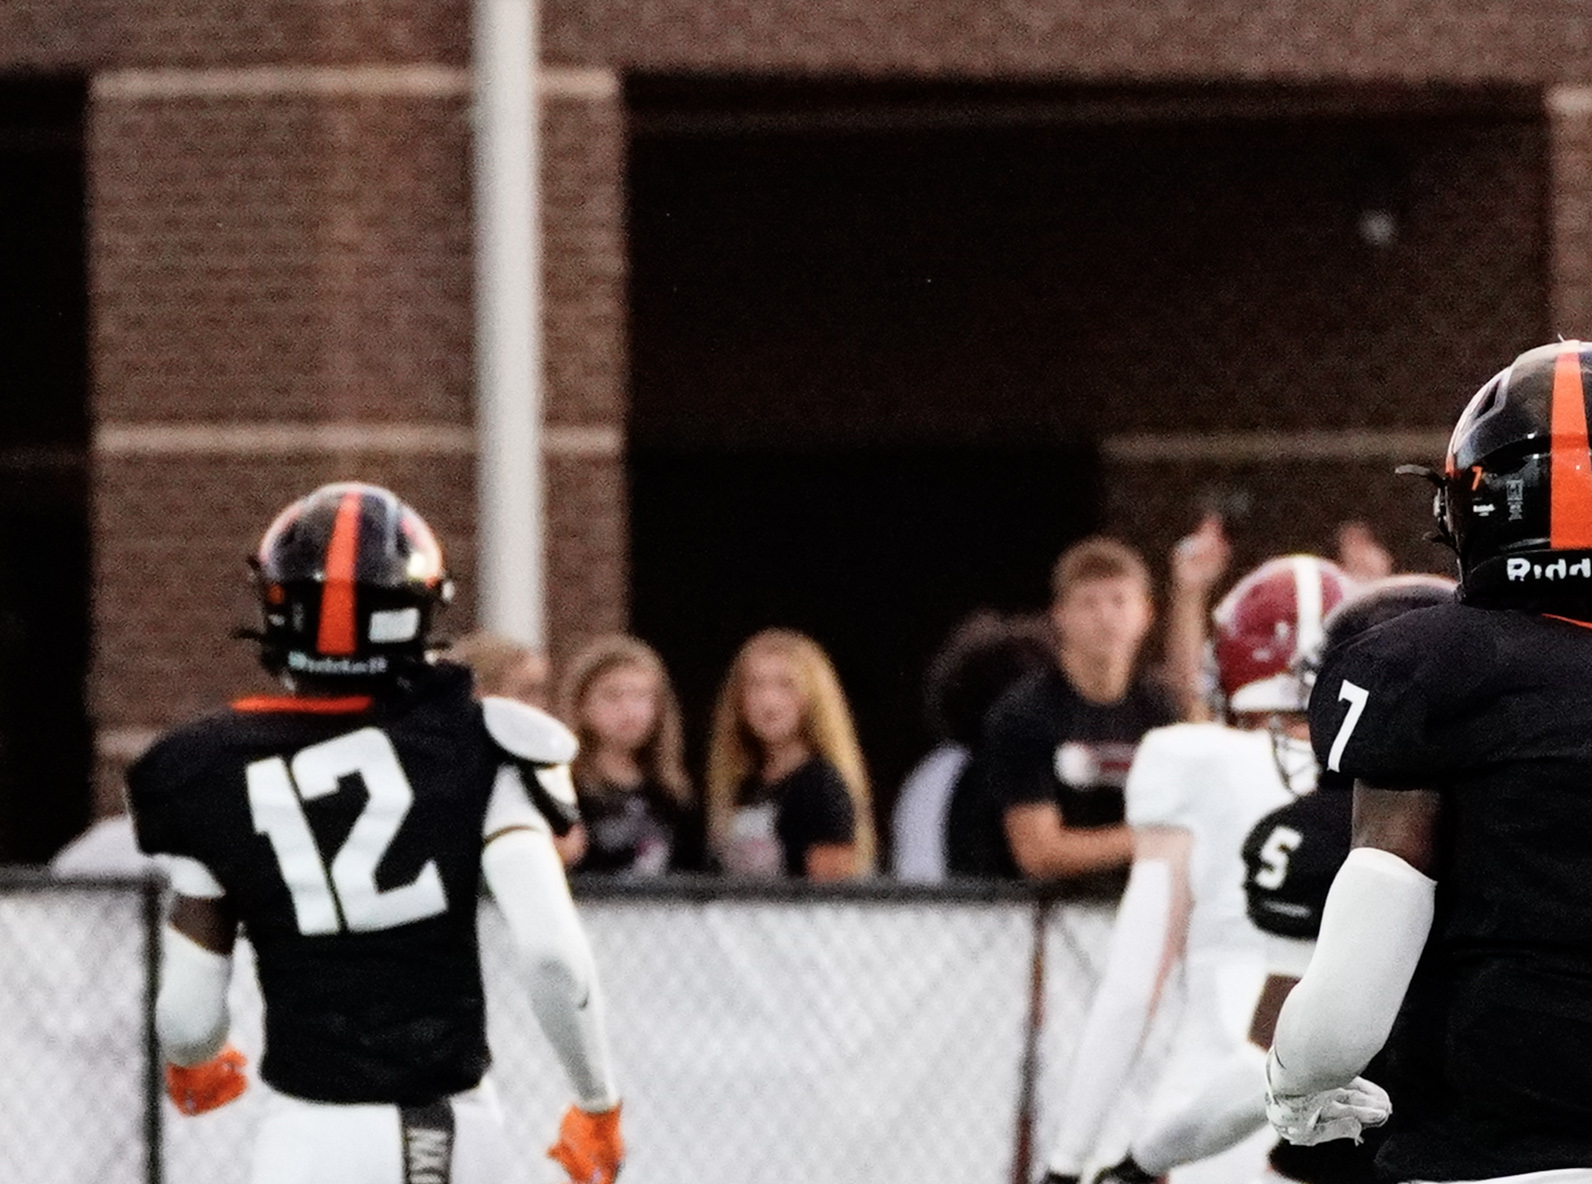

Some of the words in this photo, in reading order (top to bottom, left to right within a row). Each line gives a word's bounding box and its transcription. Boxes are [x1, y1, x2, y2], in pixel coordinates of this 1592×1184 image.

[1471, 465, 1484, 492] 7
[1327, 679, 1370, 773] 7
[246, 727, 448, 936] 12
[1255, 826, 1303, 890] 5
